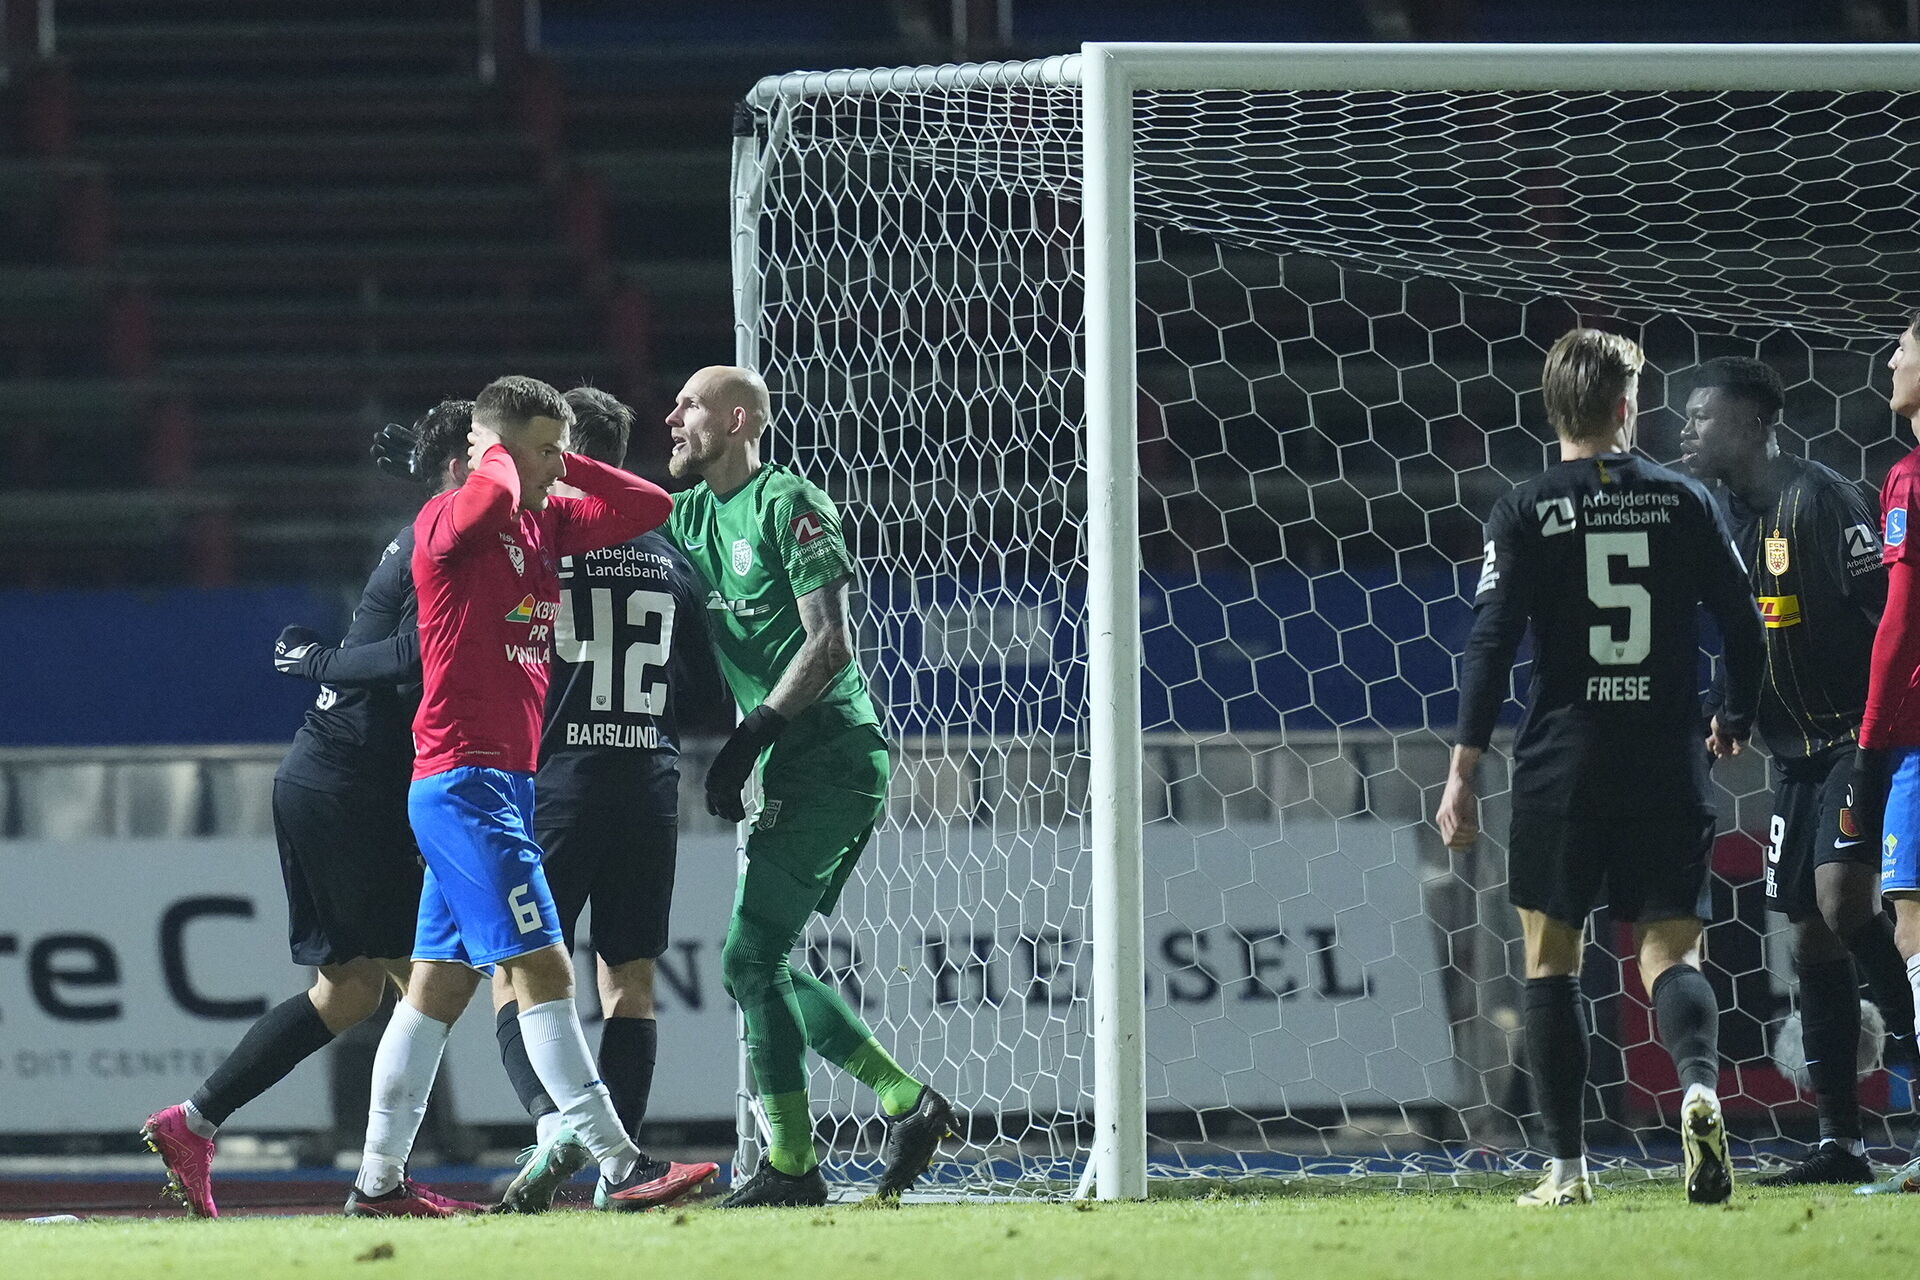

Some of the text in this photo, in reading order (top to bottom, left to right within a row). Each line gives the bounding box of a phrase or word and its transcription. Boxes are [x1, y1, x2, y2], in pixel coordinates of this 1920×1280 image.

[1582, 490, 1680, 512] Arbejdernes
[1584, 508, 1671, 527] Landsbank
[585, 547, 674, 569] Arbejdernes
[586, 563, 669, 581] Landsbank
[1585, 531, 1651, 665] 5
[554, 588, 676, 717] 42
[1586, 676, 1651, 702] FRESE
[566, 722, 658, 749] BARSLUND
[1768, 814, 1786, 864] 9
[508, 883, 543, 935] 6
[918, 923, 1375, 1005] HESEL
